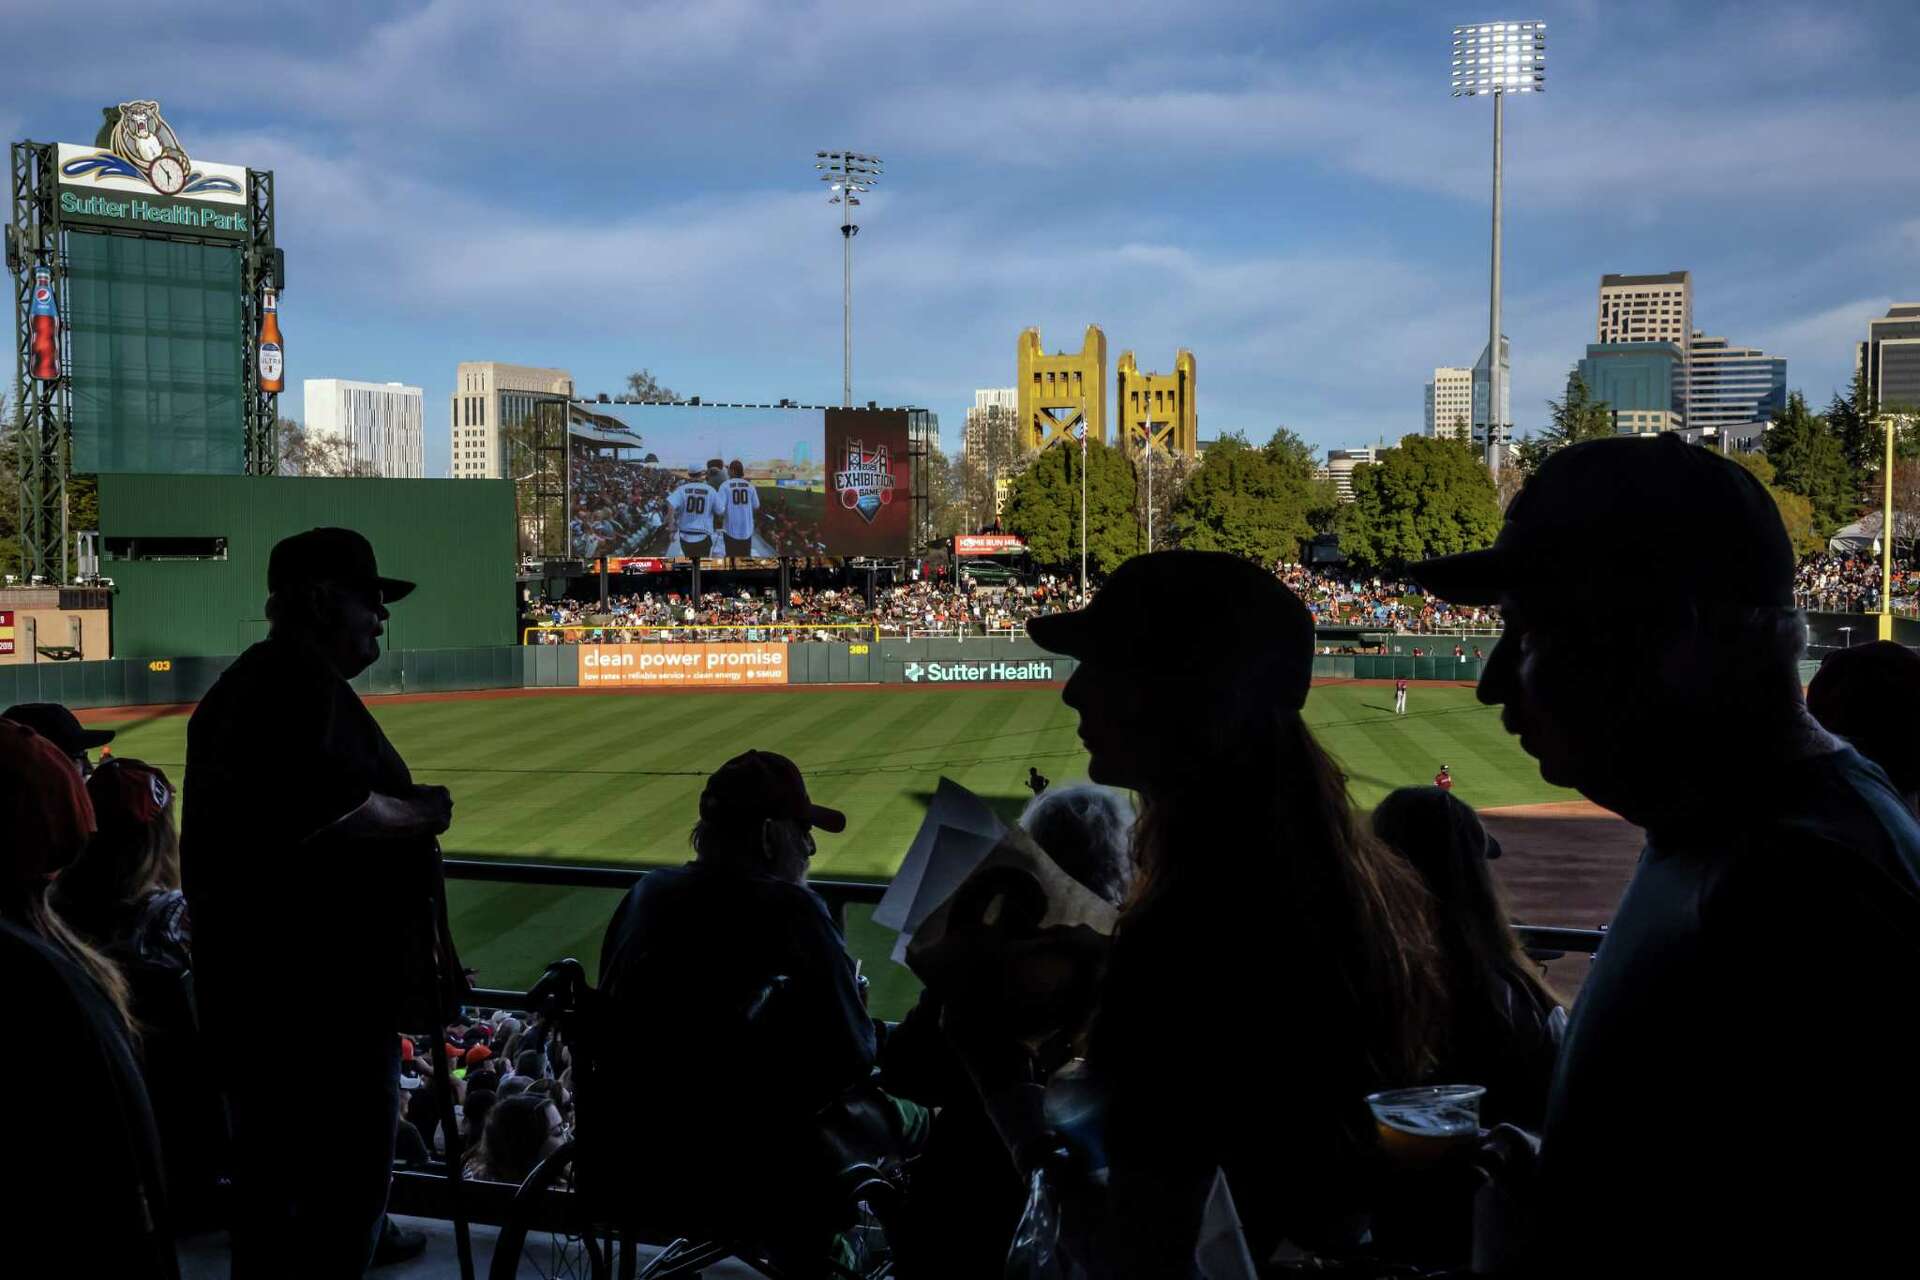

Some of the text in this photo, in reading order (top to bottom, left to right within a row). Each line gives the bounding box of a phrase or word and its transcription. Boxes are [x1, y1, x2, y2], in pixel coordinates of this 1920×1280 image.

[61, 192, 248, 232] Sutter Health Park
[835, 472, 896, 489] EXHIBITION
[733, 488, 748, 505] 00
[860, 488, 880, 496] GAME
[687, 495, 705, 514] 00
[986, 538, 1003, 547] RUN
[149, 660, 171, 671] 403
[584, 649, 782, 669] clean power promise
[928, 662, 1052, 681] Sutter Health
